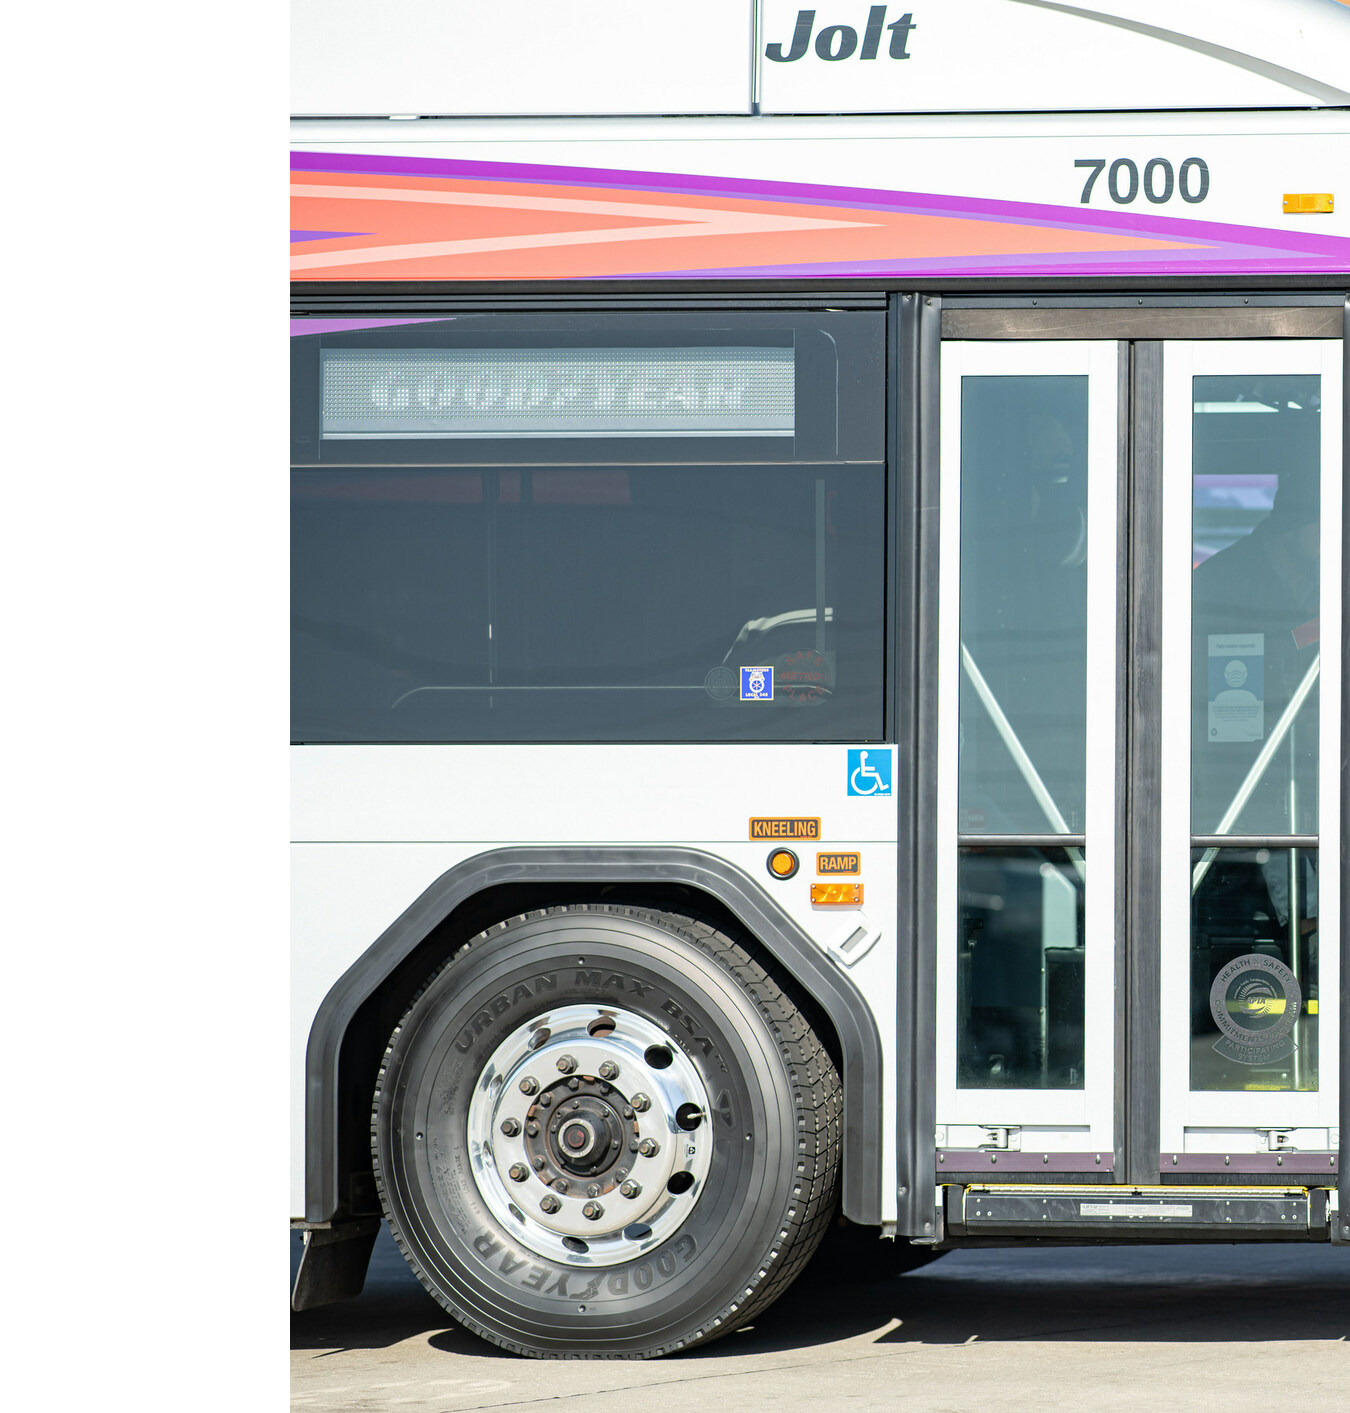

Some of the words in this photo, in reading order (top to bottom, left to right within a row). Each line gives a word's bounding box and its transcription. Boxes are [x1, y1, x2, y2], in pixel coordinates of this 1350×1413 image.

[765, 6, 917, 62] Jolt
[1074, 157, 1210, 204] 7000
[753, 821, 816, 837] KNEELING
[819, 856, 857, 870] RAMP
[1220, 959, 1251, 983] HEALTH
[1263, 959, 1292, 983] SAFETY
[454, 973, 558, 1054] URBAN
[574, 970, 655, 999] MAX
[661, 998, 715, 1058] BSA
[1225, 1040, 1286, 1053] PARTICIPATING
[1237, 1053, 1270, 1062] SYSTEM
[472, 1233, 698, 1300] GOODYEAR
